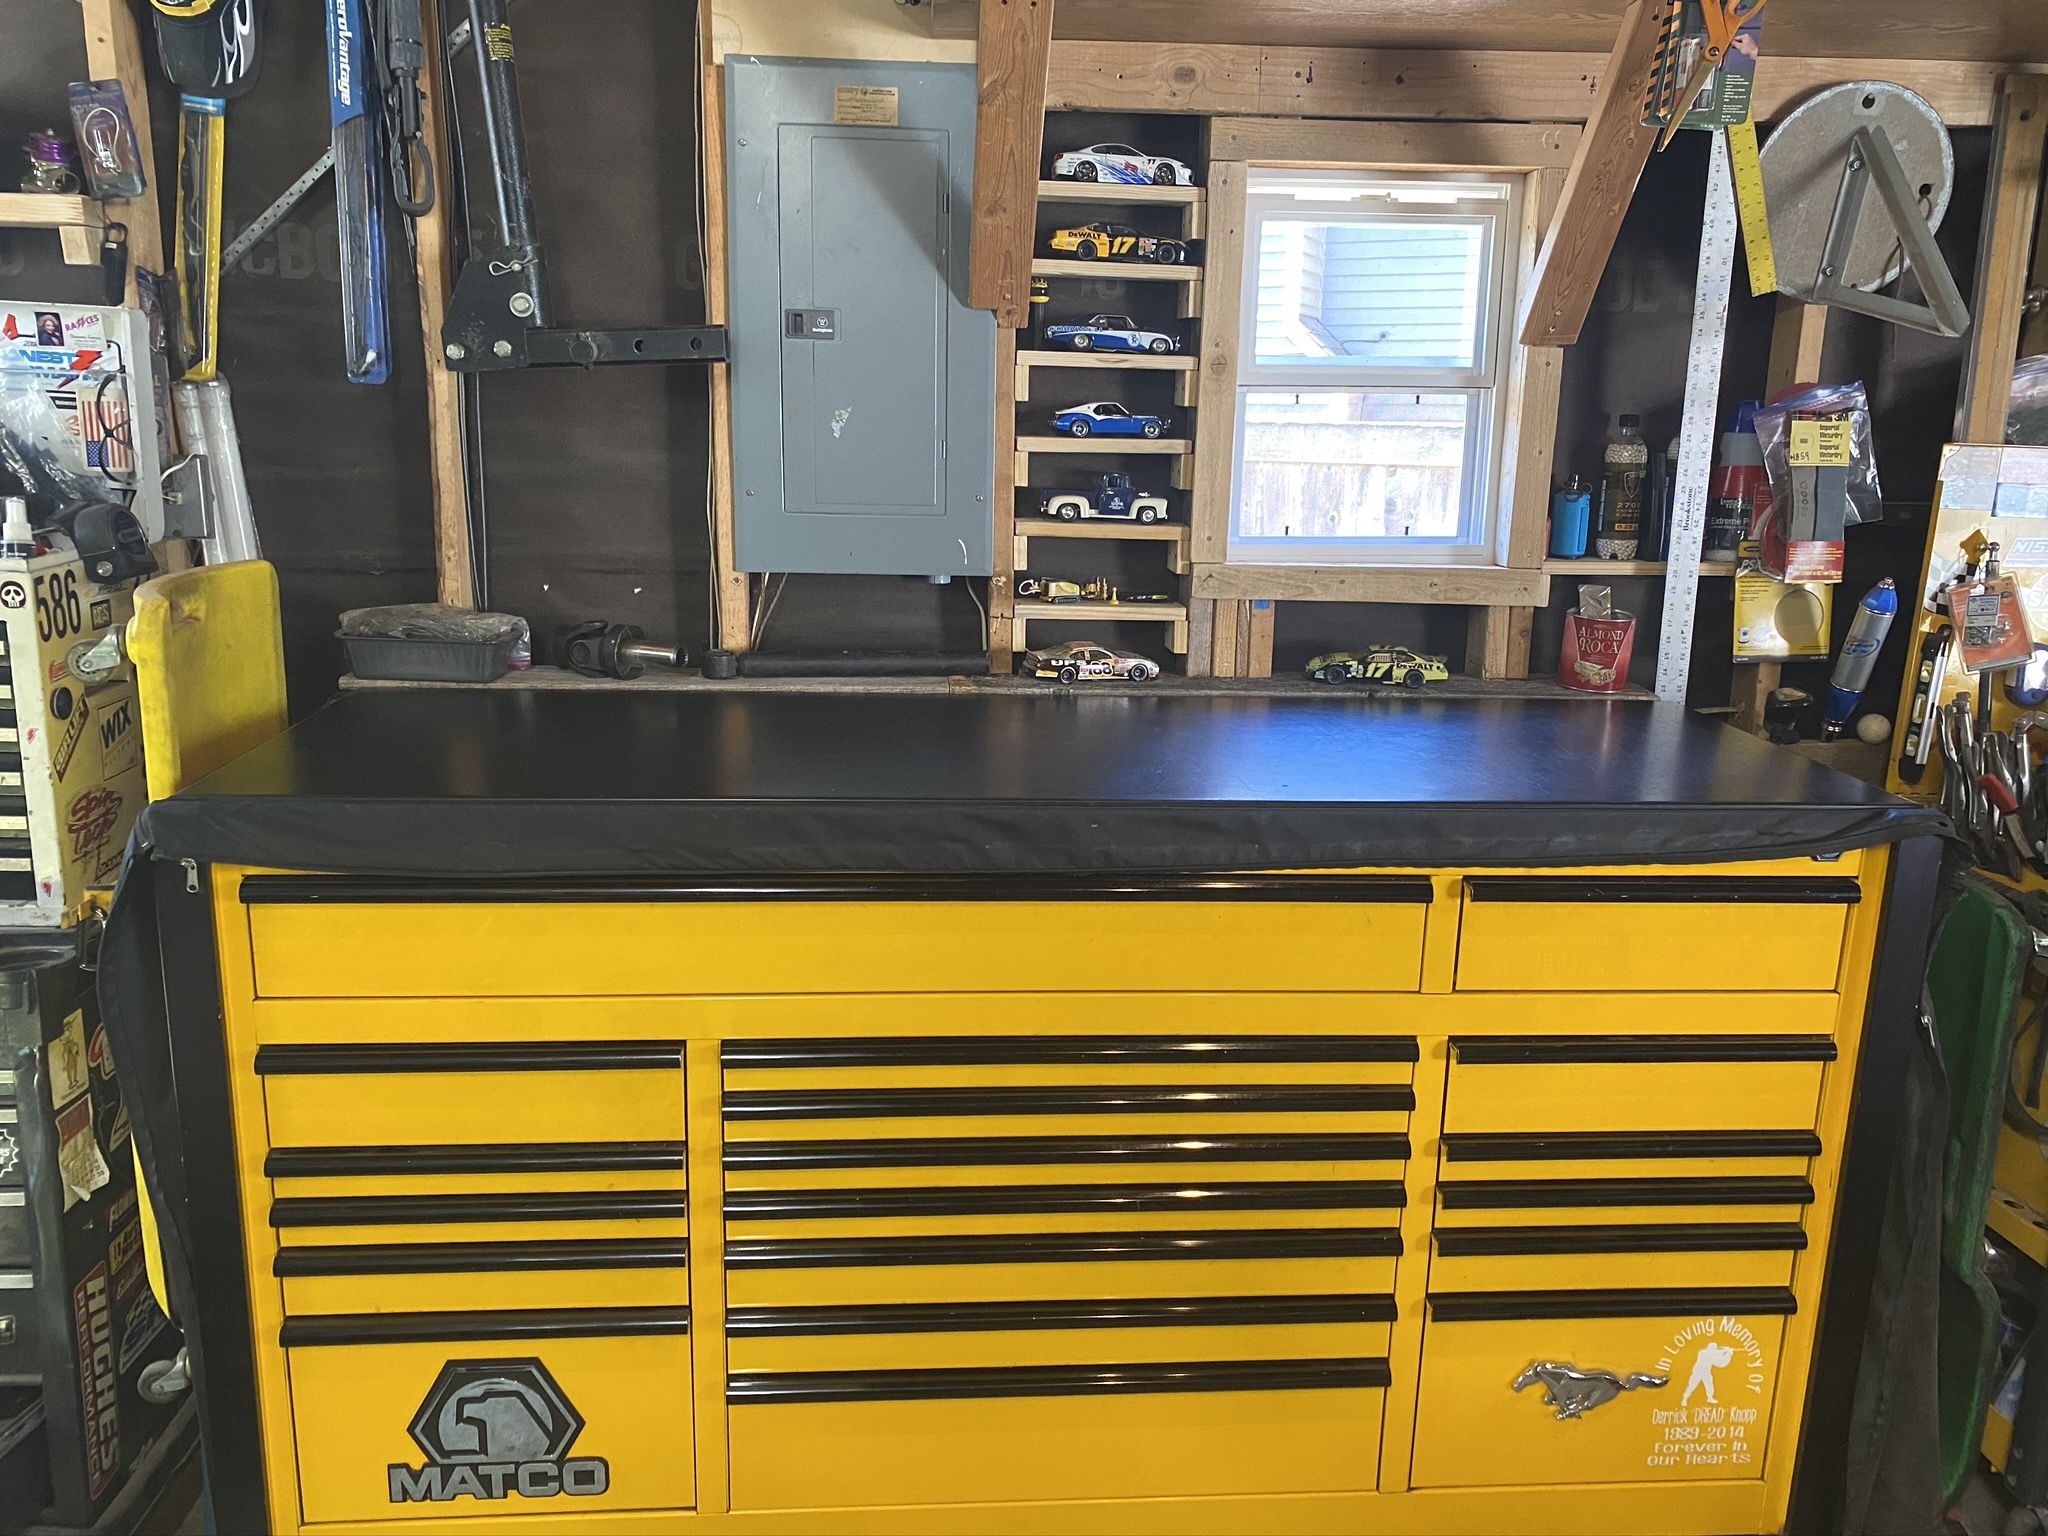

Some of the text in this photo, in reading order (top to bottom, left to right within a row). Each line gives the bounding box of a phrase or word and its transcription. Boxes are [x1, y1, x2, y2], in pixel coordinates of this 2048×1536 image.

[1111, 236, 1136, 254] 17
[1834, 412, 1849, 422] 3M
[1682, 486, 1693, 531] Brookstone
[1711, 517, 1741, 526] Extreme
[33, 569, 82, 642] 586
[1579, 626, 1624, 640] ALMOND
[1579, 637, 1619, 654] ROCA
[1365, 662, 1391, 678] 17
[100, 700, 133, 750] WIX
[1663, 1318, 1715, 1355] Loving
[1719, 1316, 1764, 1368] Memory
[1654, 1357, 1673, 1371] In
[86, 1276, 119, 1471] HUGHES
[77, 1291, 100, 1489] PERFORMANCE
[1652, 1408, 1688, 1424] Derrick
[1654, 1442, 1727, 1454] Forever
[1685, 1453, 1751, 1465] Hearts
[388, 1458, 610, 1502] MATCO
